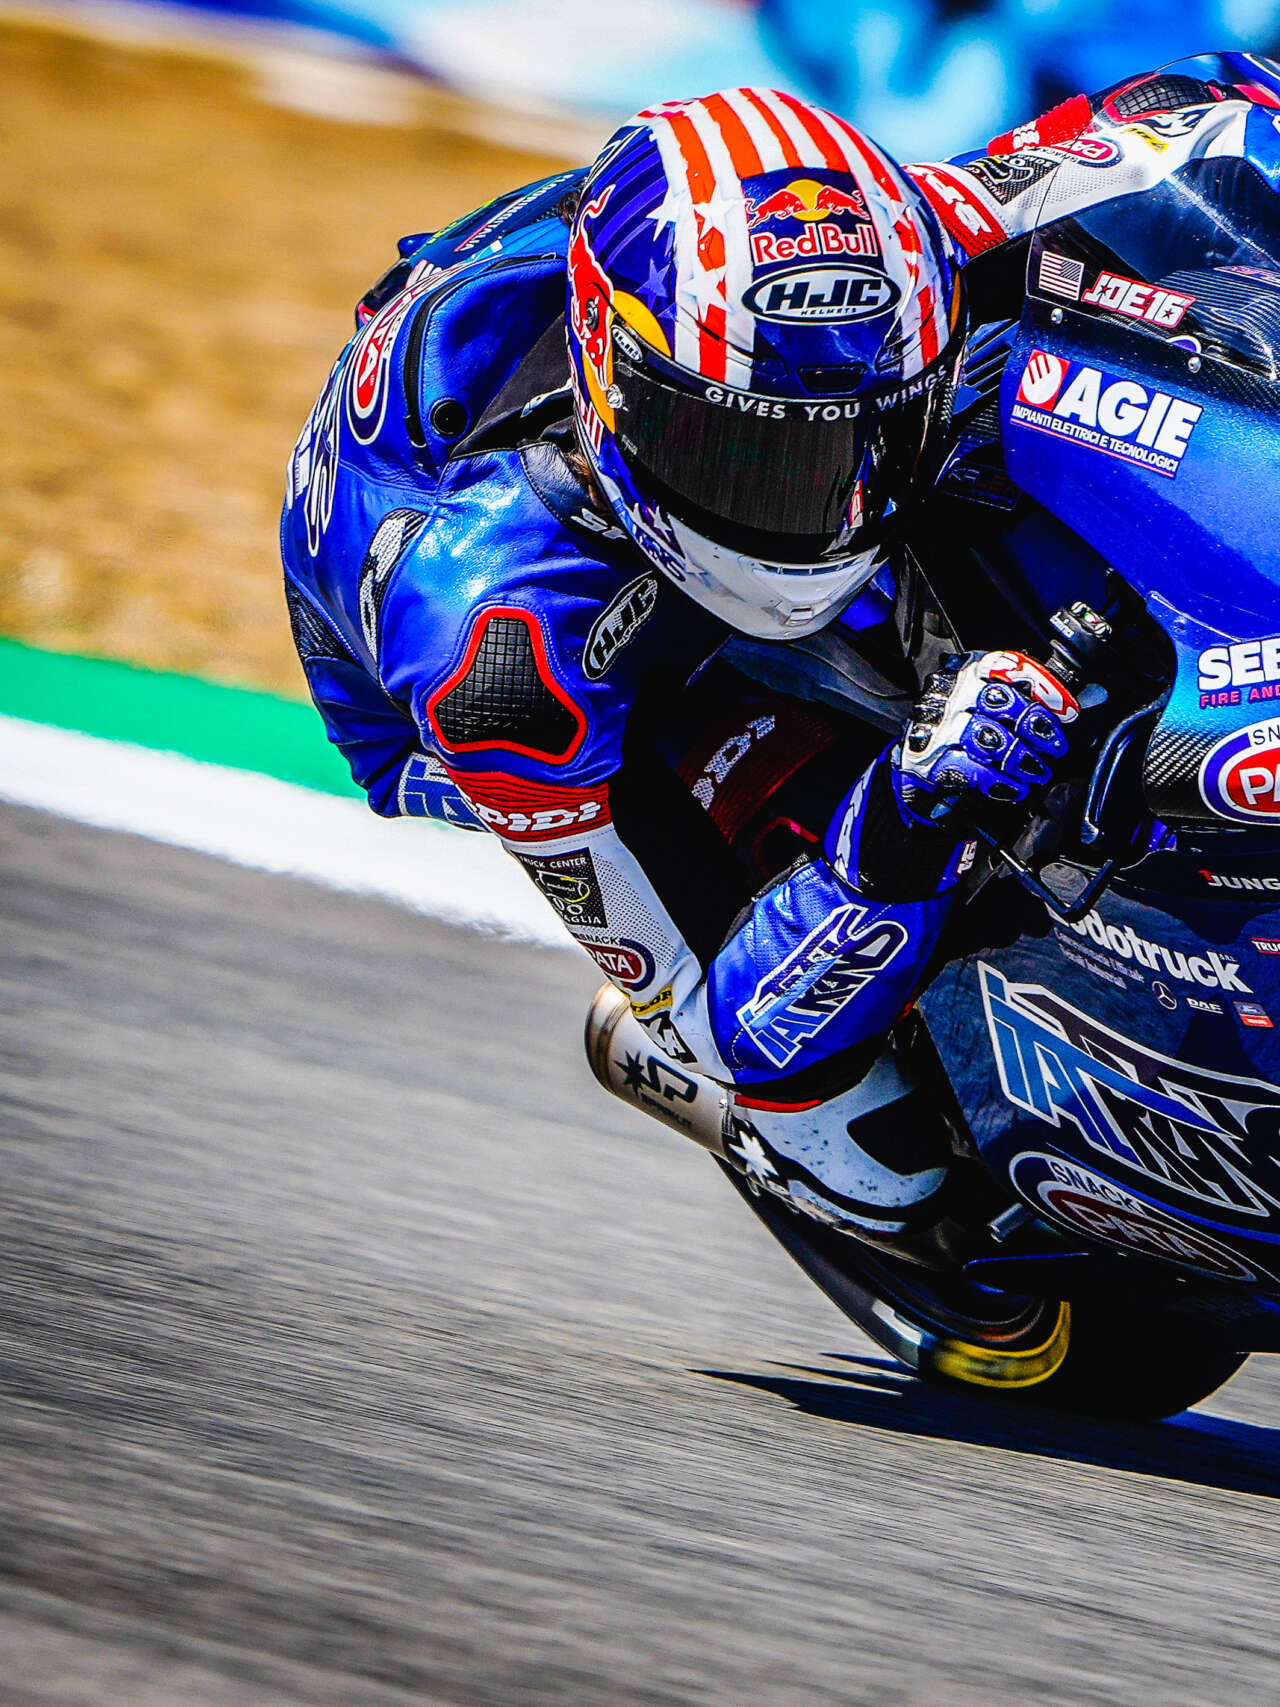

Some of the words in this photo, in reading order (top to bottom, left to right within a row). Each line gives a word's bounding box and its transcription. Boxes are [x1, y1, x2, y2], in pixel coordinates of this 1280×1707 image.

[751, 223, 819, 265] Red
[818, 223, 878, 257] Bull
[765, 279, 882, 312] HJC
[801, 307, 857, 316] HELMETS
[1081, 272, 1195, 327] JOE16
[705, 386, 786, 419] GIVES
[804, 402, 861, 421] YOU
[875, 364, 947, 411] WINGS
[1052, 367, 1204, 458] AGIE
[1012, 404, 1052, 428] IMPIANTI
[1051, 420, 1101, 446] ELETTRICI
[1099, 435, 1110, 447] E
[1108, 438, 1180, 472] TECNOLOGICI
[1200, 691, 1241, 707] FIRE
[550, 857, 588, 868] CENTER
